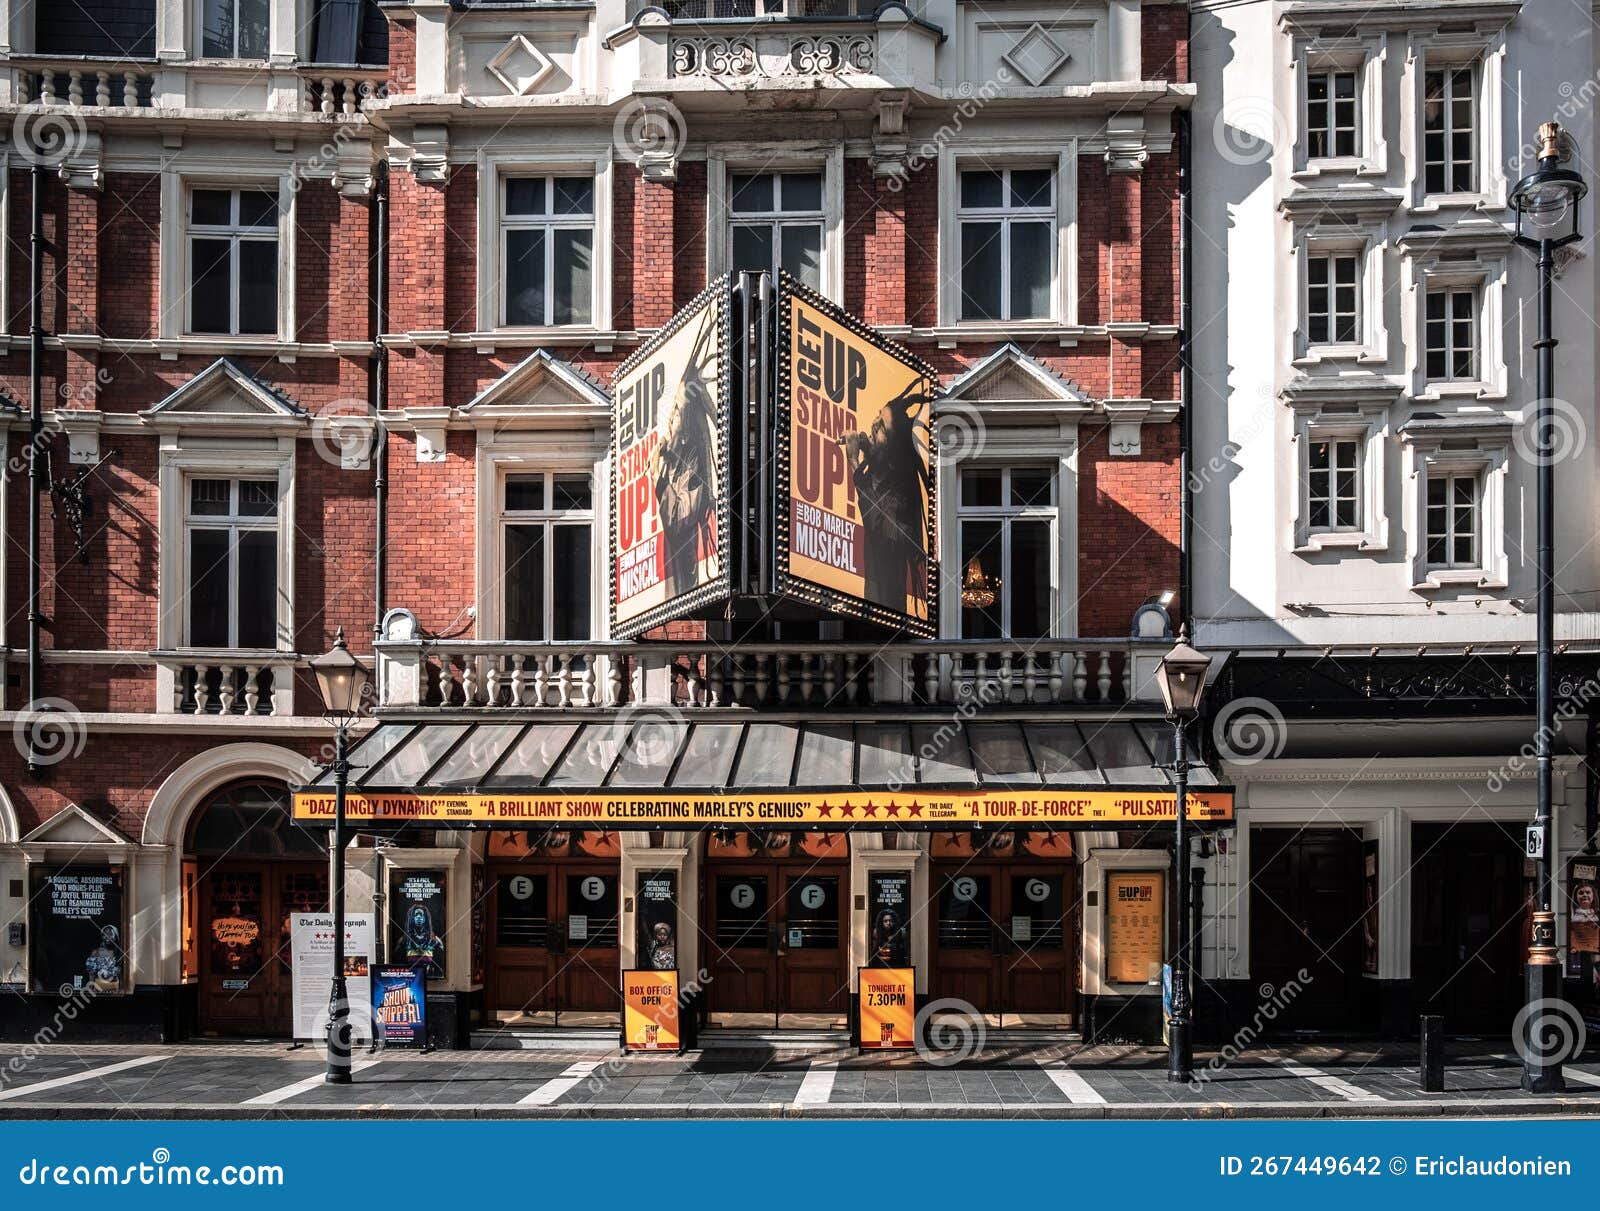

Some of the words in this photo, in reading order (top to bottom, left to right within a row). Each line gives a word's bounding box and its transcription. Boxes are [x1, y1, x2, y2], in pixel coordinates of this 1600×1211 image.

[797, 307, 821, 391] GET
[824, 330, 867, 412] UP
[635, 362, 665, 439] UP
[620, 385, 634, 452] GET
[797, 425, 856, 519] UP!
[620, 474, 657, 551] UP!
[796, 501, 804, 520] THE
[804, 504, 821, 528] BOB
[824, 512, 856, 541] MARLEY
[796, 522, 857, 573] MUSICAL
[620, 555, 659, 600] MUSICAL
[480, 801, 495, 816] "A
[500, 801, 563, 817] BRILLIANT
[566, 801, 603, 817] SHOW
[607, 801, 689, 817] CELEBRATING
[693, 801, 754, 817] MARLEY'S
[758, 802, 811, 818] GENIUS"
[963, 801, 979, 816] "A
[517, 881, 526, 894] E
[588, 882, 598, 895] E
[958, 882, 971, 896] G
[1030, 882, 1043, 896] G
[1127, 886, 1139, 897] UP
[81, 892, 105, 900] THEATRE
[738, 889, 747, 903] F
[809, 889, 818, 903] F
[52, 907, 80, 915] MARLEY'S
[300, 918, 314, 927] The
[315, 918, 333, 927] Daily
[629, 986, 645, 996] BOX
[646, 986, 673, 996] OFFICE
[867, 984, 896, 993] TONIGHT
[897, 984, 906, 993] AT
[384, 988, 410, 1007] SHOW
[641, 996, 661, 1006] OPEN
[867, 993, 906, 1006] 7.30PM
[376, 1003, 421, 1023] STOPPER!
